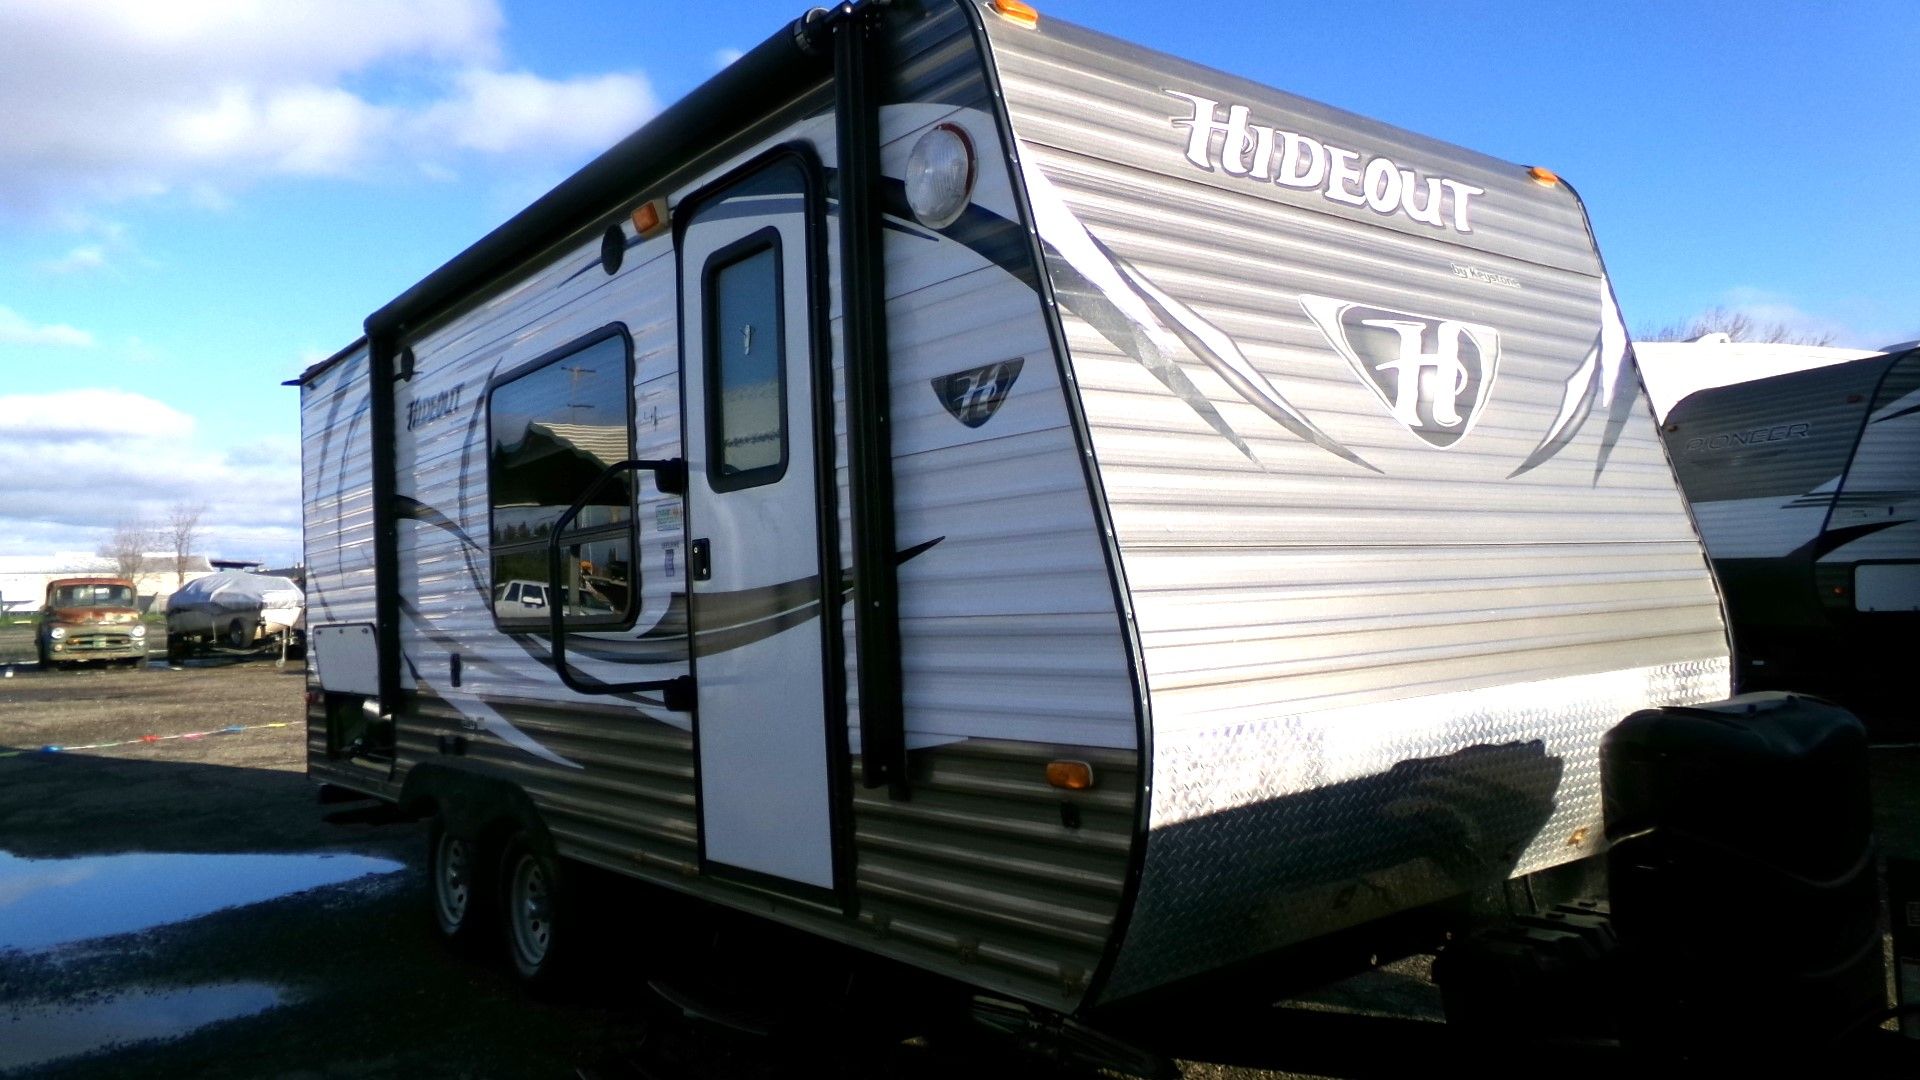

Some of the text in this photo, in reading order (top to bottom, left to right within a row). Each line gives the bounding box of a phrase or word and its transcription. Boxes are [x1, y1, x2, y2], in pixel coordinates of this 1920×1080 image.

[1162, 88, 1487, 234] HIDEOUT
[1449, 262, 1468, 279] by
[1685, 422, 1810, 452] PIONEER
